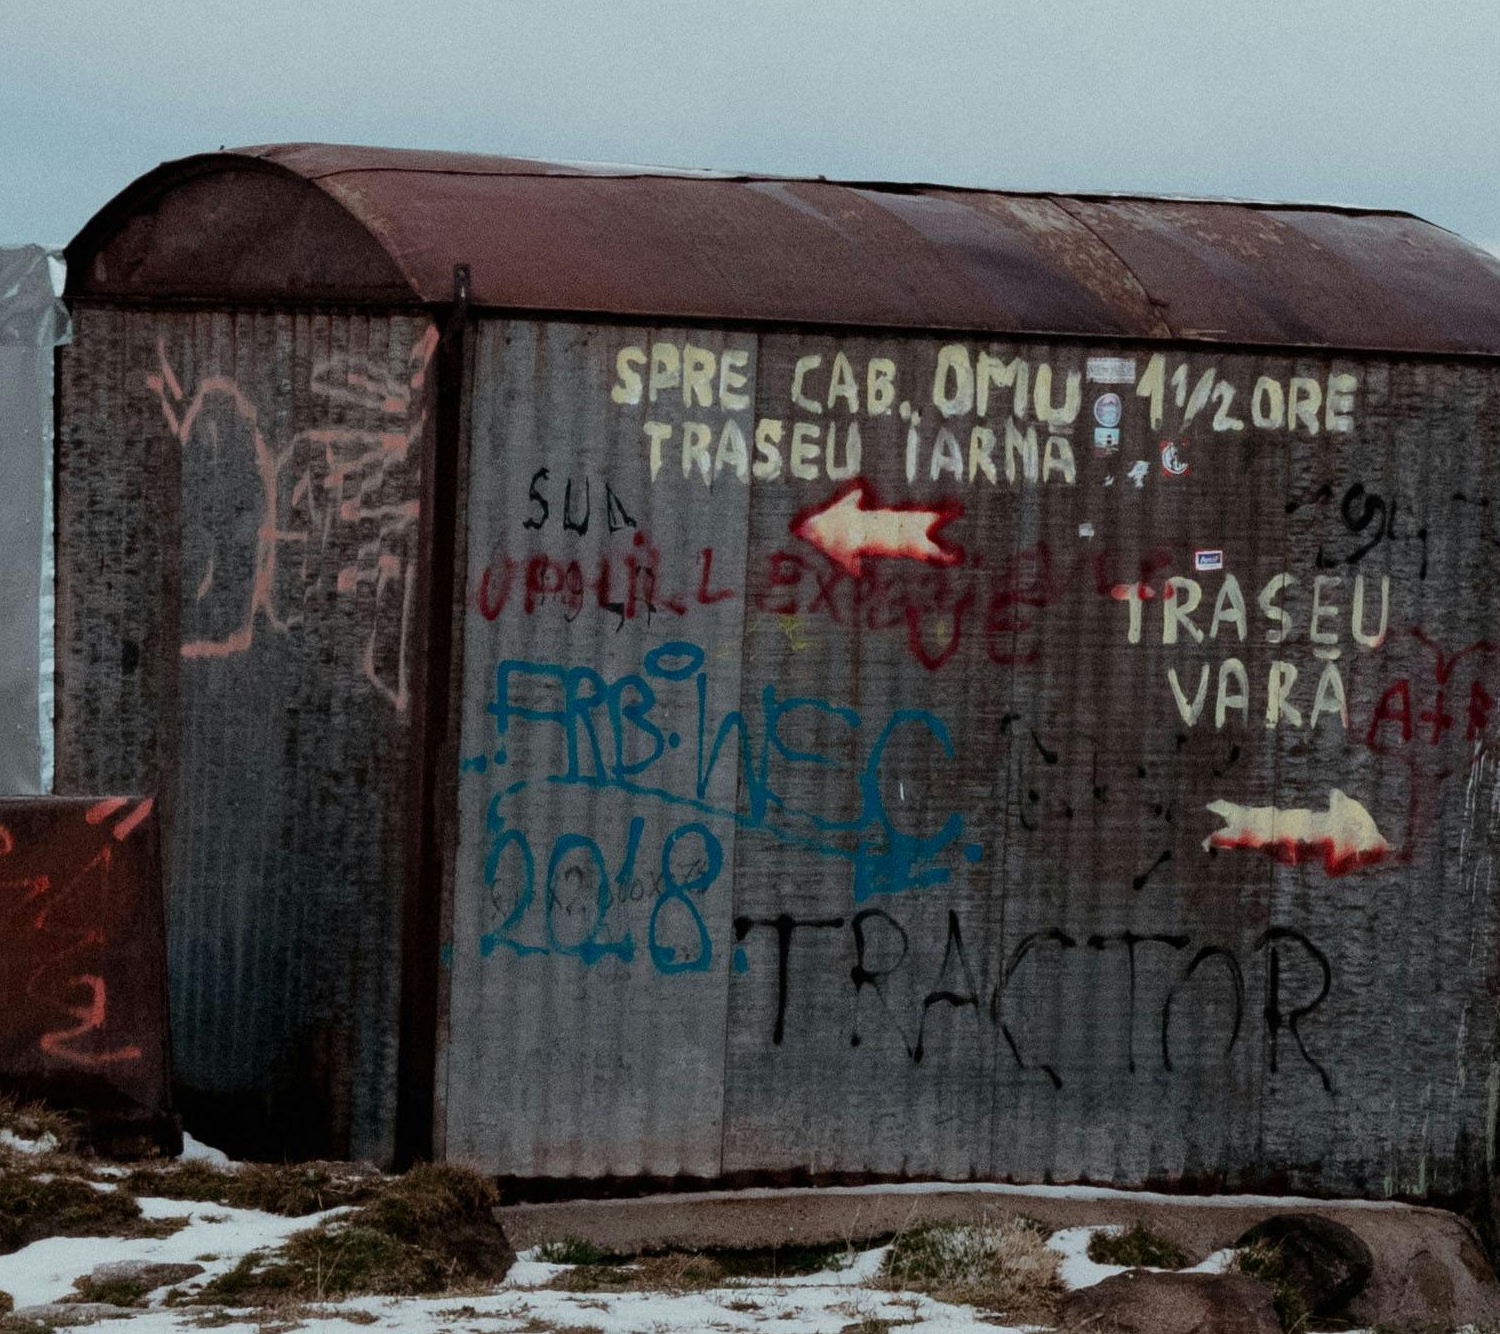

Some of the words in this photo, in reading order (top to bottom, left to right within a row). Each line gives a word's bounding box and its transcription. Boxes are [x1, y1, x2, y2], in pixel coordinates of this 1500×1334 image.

[611, 343, 750, 411] SPRE
[933, 343, 1082, 424] OMU
[1250, 373, 1358, 435] ORE
[643, 418, 861, 485] TRASEU
[1111, 573, 1389, 648] TRASEU
[480, 816, 724, 975] 2018
[732, 907, 1334, 1093] TRACTOR
